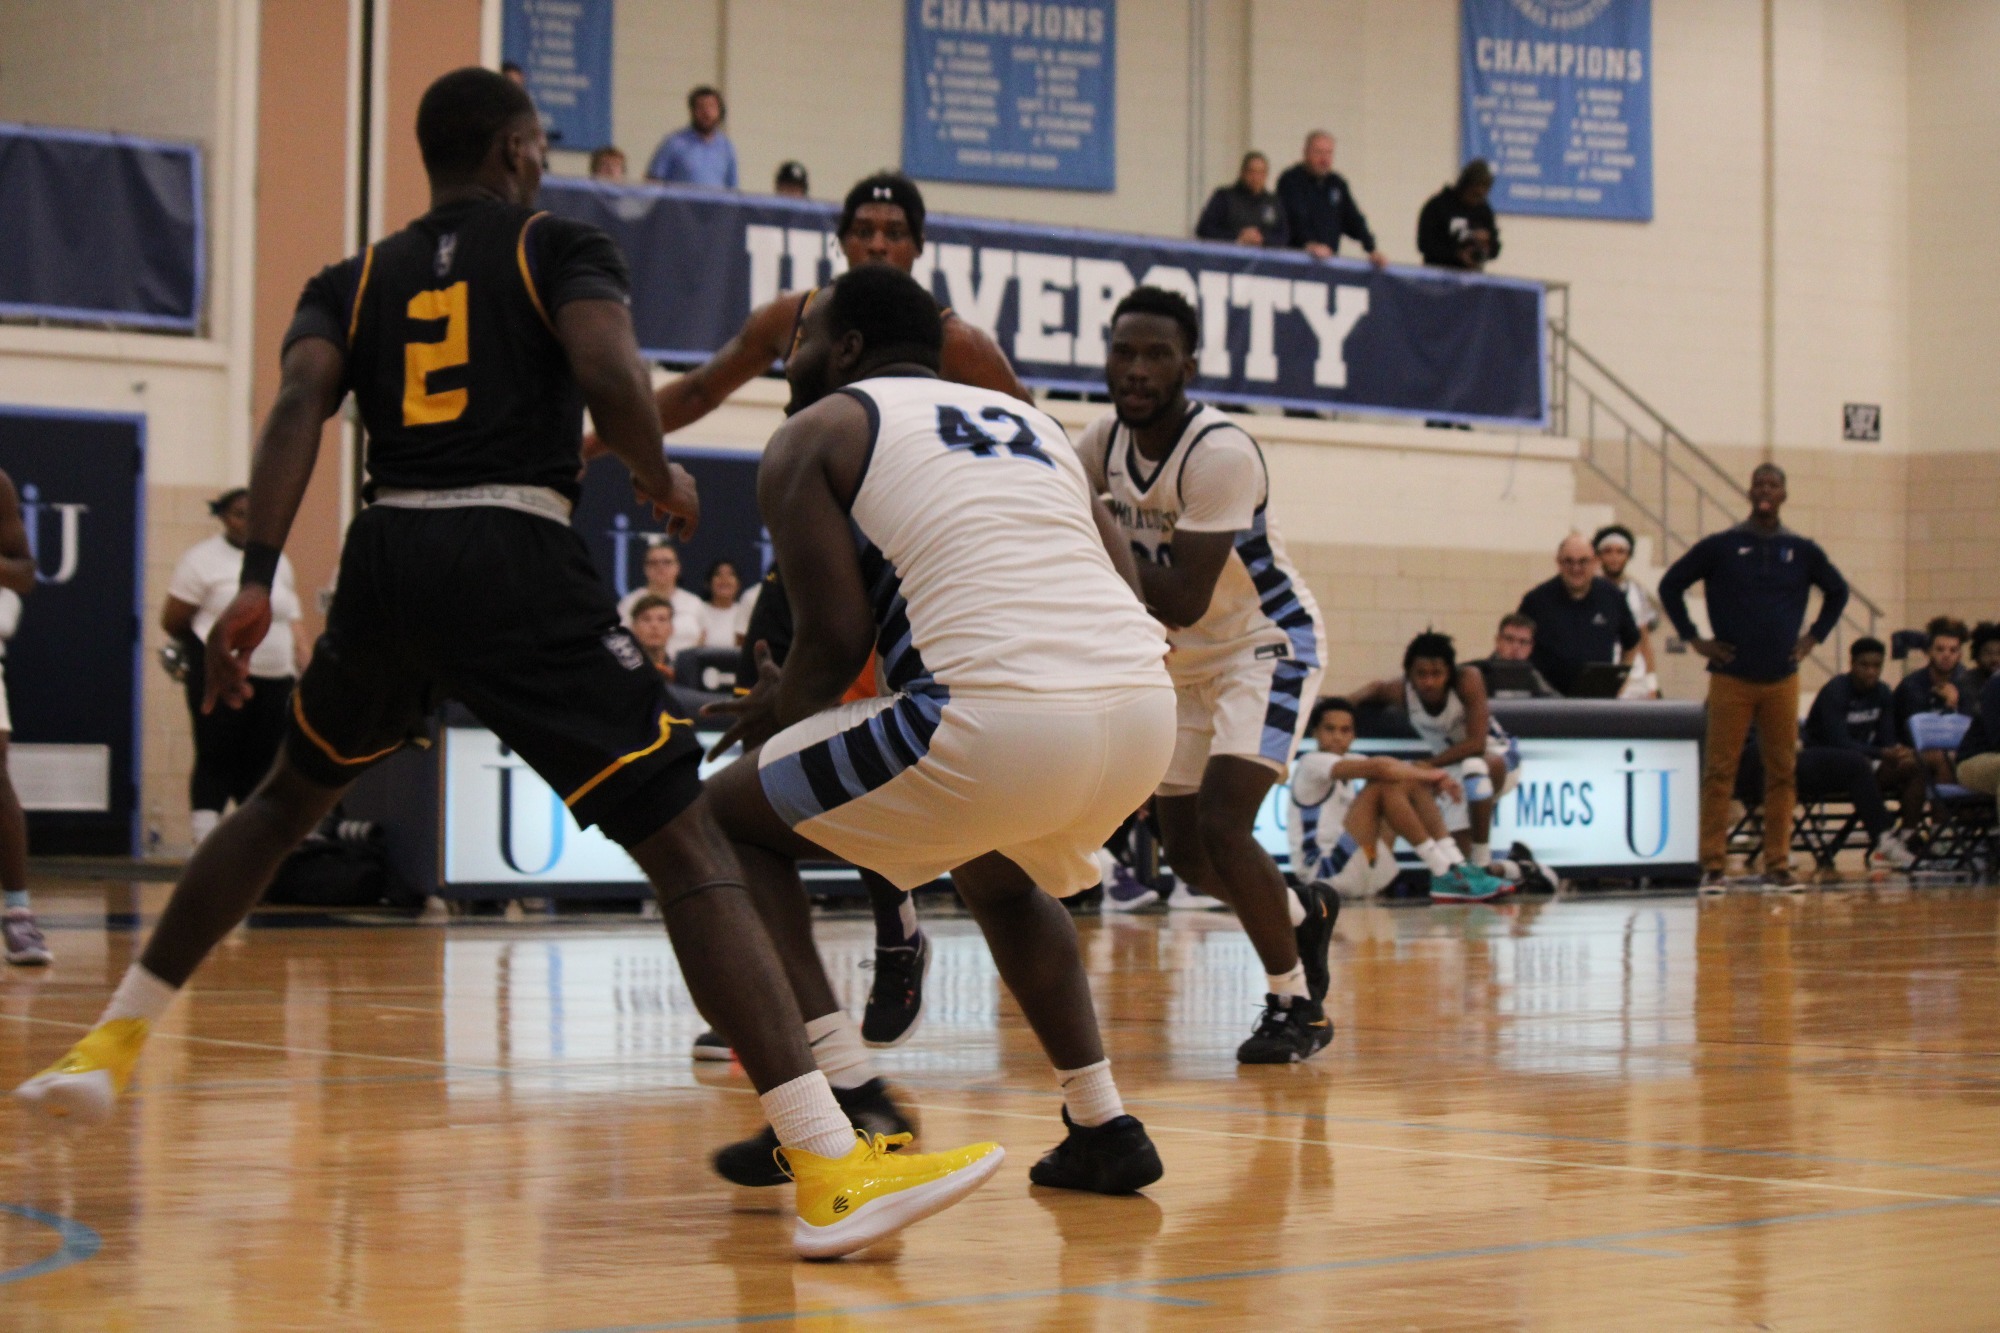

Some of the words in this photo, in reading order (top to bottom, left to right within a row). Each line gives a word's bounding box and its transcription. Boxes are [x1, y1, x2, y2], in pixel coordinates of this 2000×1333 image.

[921, 0, 1104, 43] CHAMPIONS
[1476, 37, 1643, 82] CHAMPIONS
[745, 224, 1369, 388] UVERITY
[402, 280, 469, 427] 2
[935, 404, 1056, 470] 42
[1516, 780, 1594, 827] MACS
